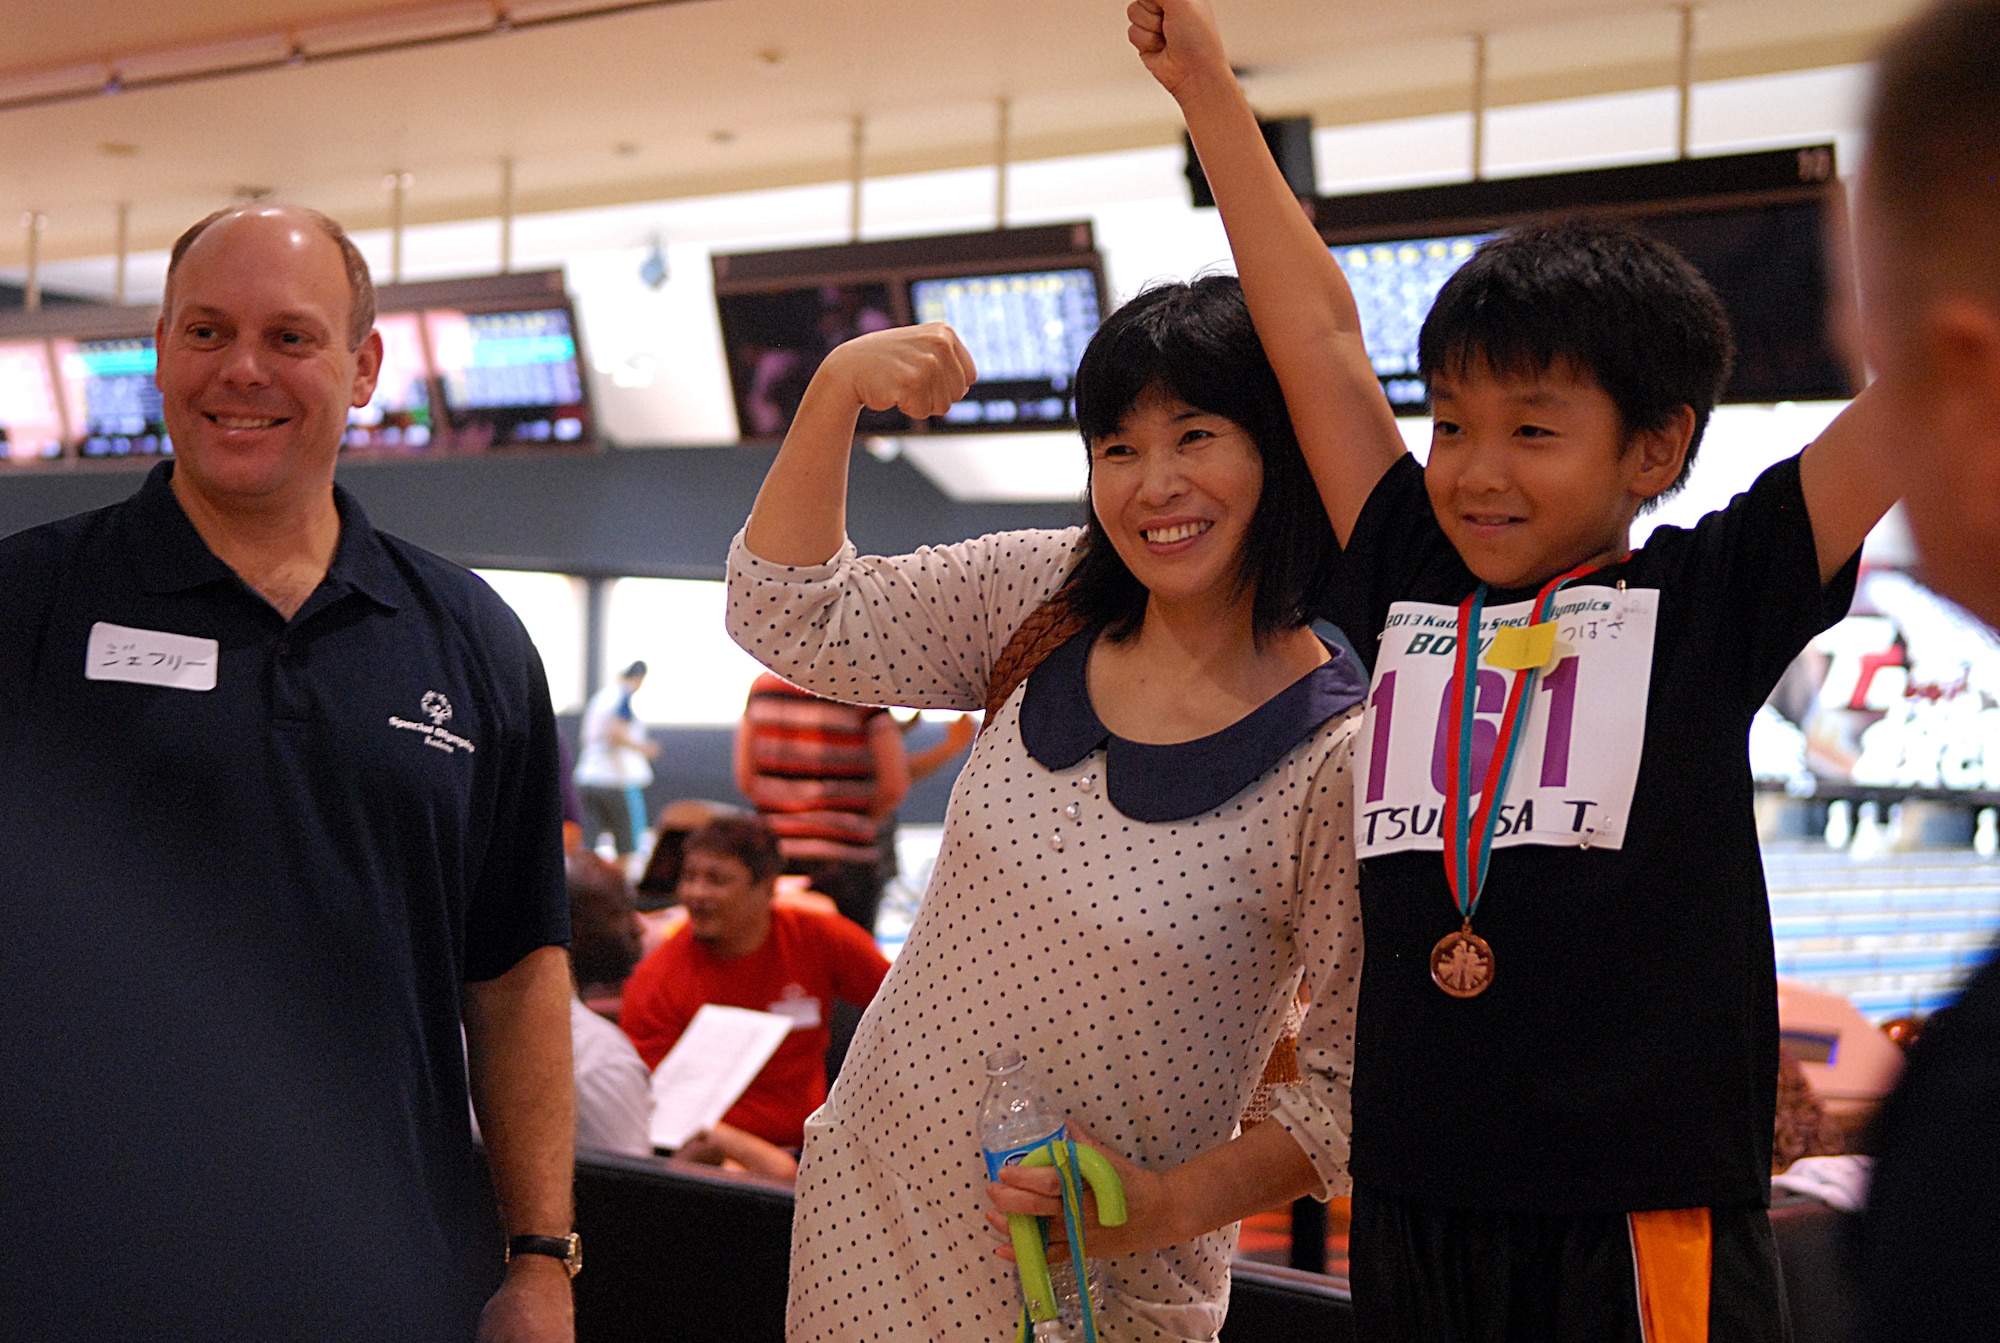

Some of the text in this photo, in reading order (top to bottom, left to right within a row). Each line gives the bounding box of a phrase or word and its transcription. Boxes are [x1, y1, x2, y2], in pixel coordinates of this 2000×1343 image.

[1423, 615, 1488, 630] Kada
[1542, 598, 1612, 621] lympics
[101, 643, 208, 671] ジェフリー
[1365, 655, 1580, 804] 161
[1363, 799, 1533, 846] TSUSA
